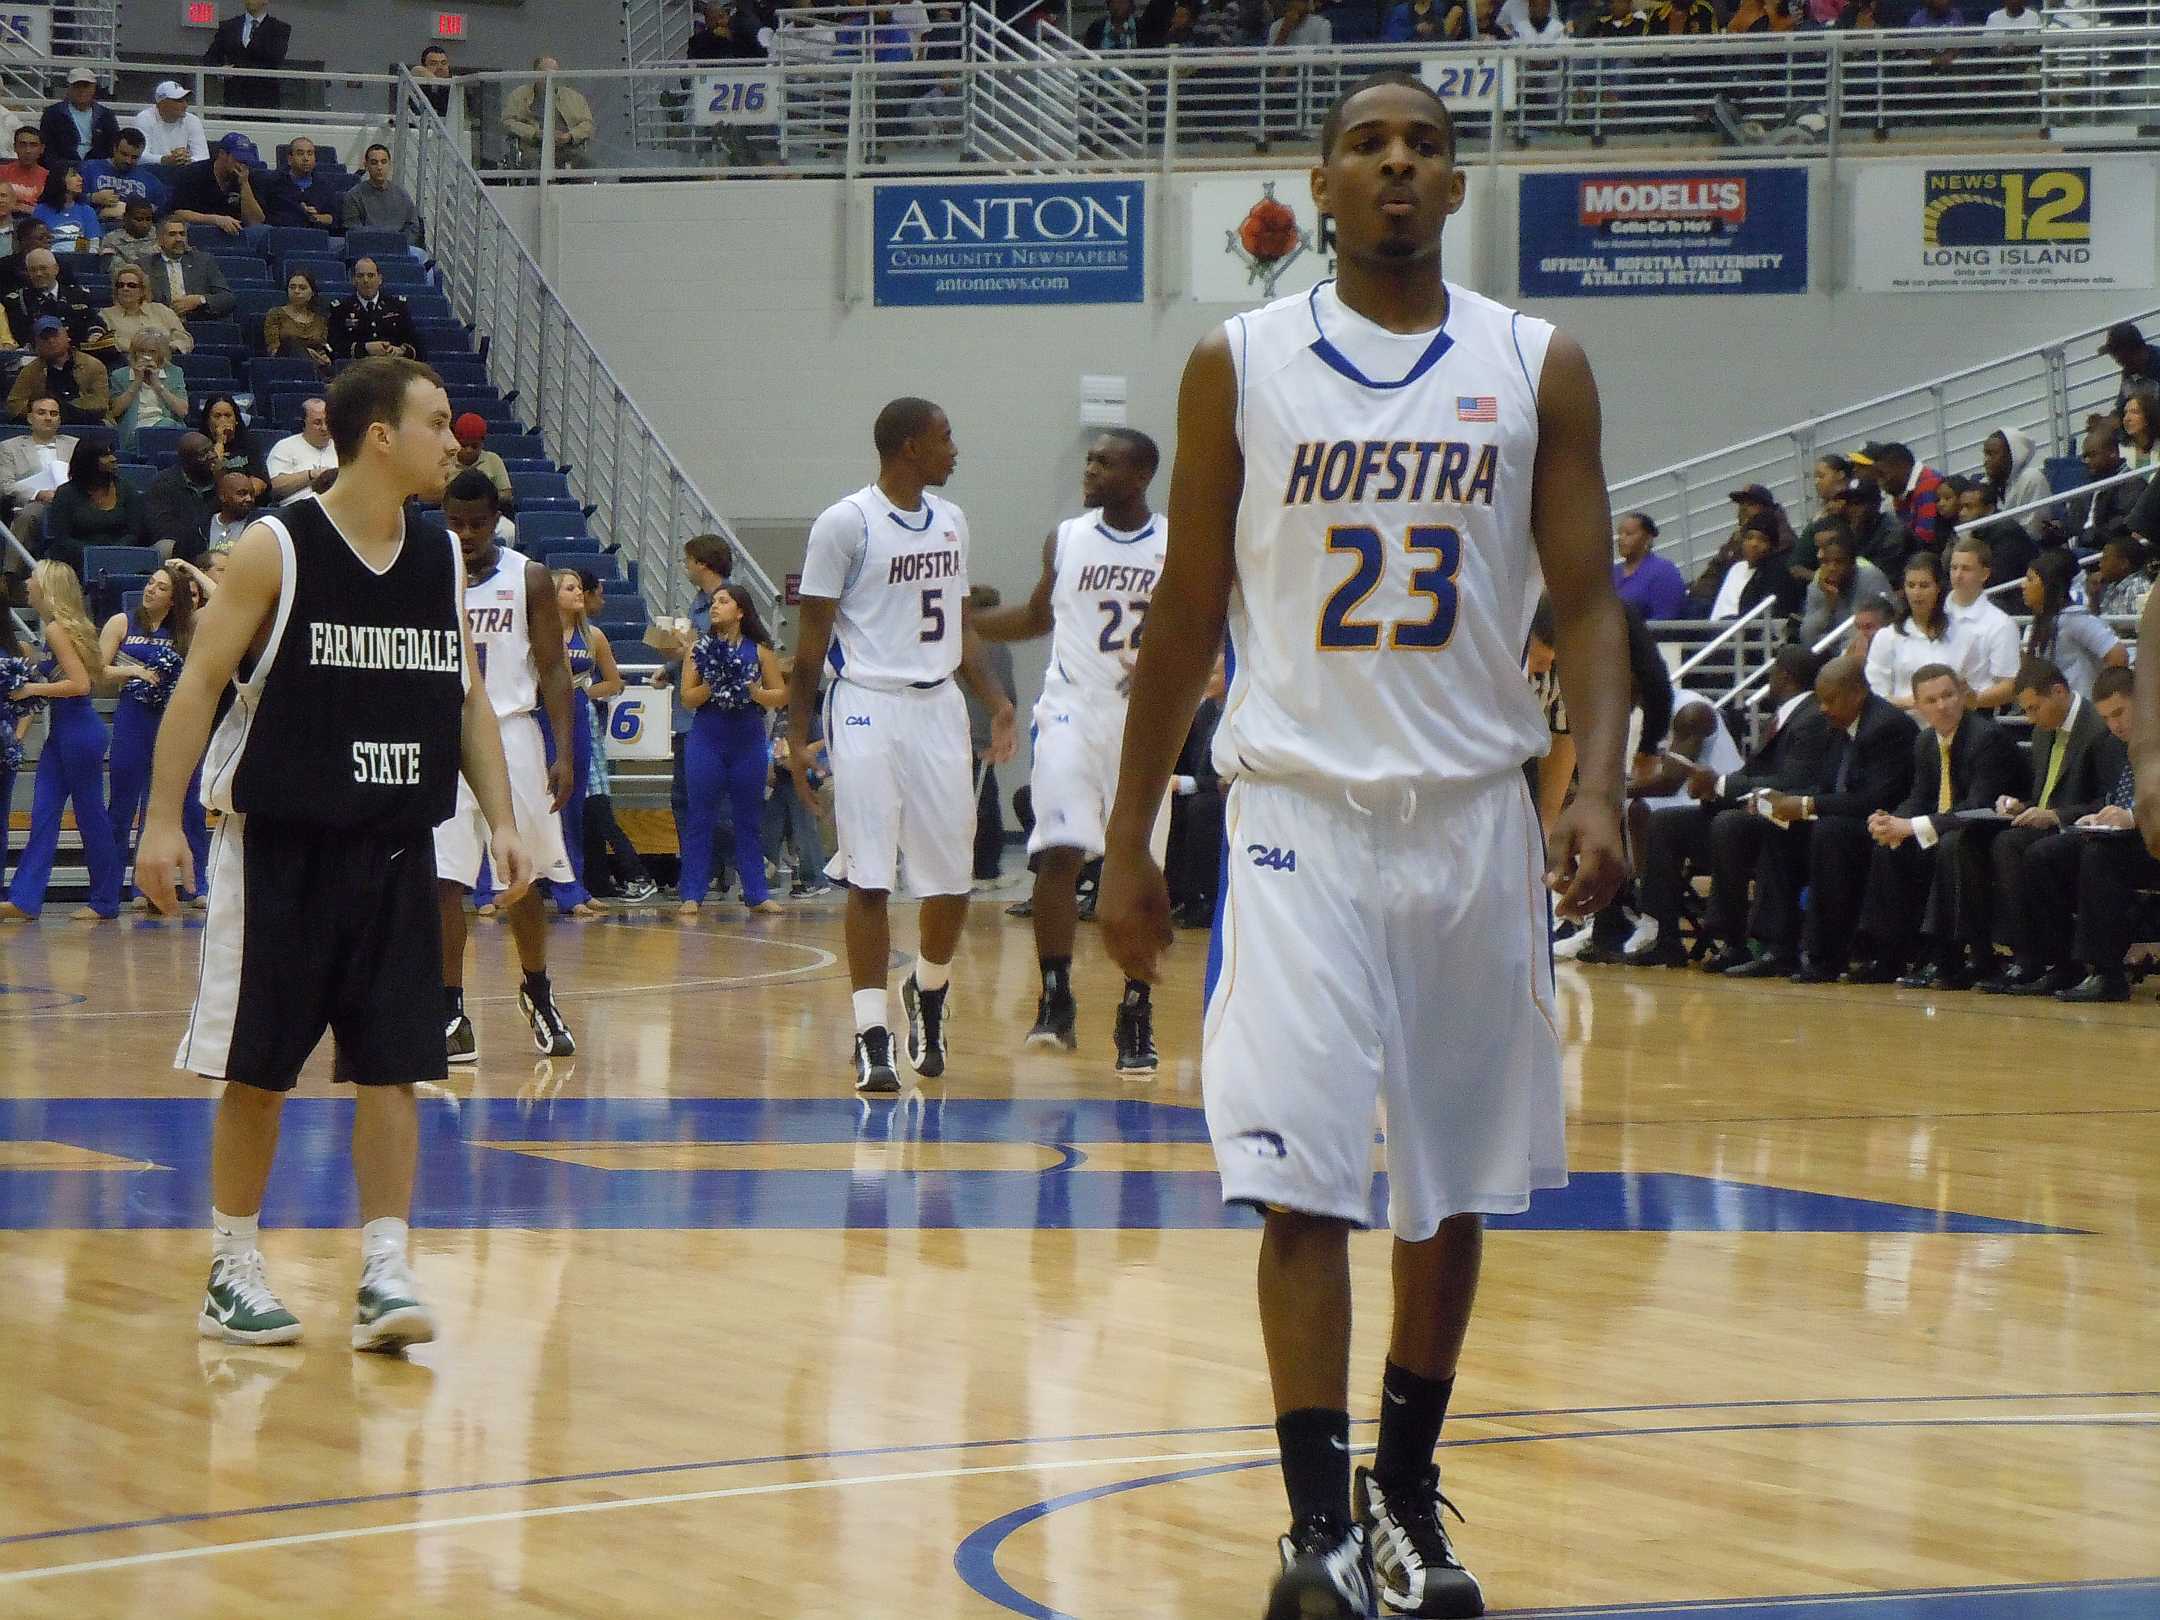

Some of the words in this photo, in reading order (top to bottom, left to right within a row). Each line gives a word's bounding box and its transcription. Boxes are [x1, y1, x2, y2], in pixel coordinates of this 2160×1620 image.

[1437, 68, 1495, 96] 217
[709, 83, 766, 111] 216
[1583, 183, 1741, 212] MODELL'S
[1931, 174, 1998, 190] NEWS
[2001, 171, 2092, 240] 12
[889, 195, 1131, 241] ANTON
[1541, 258, 1608, 272] OFFICIAL
[1615, 256, 1684, 270] HOFSTRA
[1687, 254, 1783, 269] UNIVERSITY
[1923, 249, 1990, 266] LONG
[2000, 248, 2090, 265] ISLAND
[936, 275, 1070, 292] antonnews.com
[1581, 272, 1664, 286] ATHLETICS
[1668, 270, 1743, 283] RETAILER
[1284, 440, 1499, 506] HOFSTRA
[888, 551, 960, 584] HOFSTRA
[1317, 523, 1463, 651] 23
[920, 589, 945, 643] 5
[310, 622, 459, 672] FARMINGDALE
[845, 716, 871, 726] CAA
[353, 741, 420, 784] STATE
[1247, 844, 1295, 872] CAA
